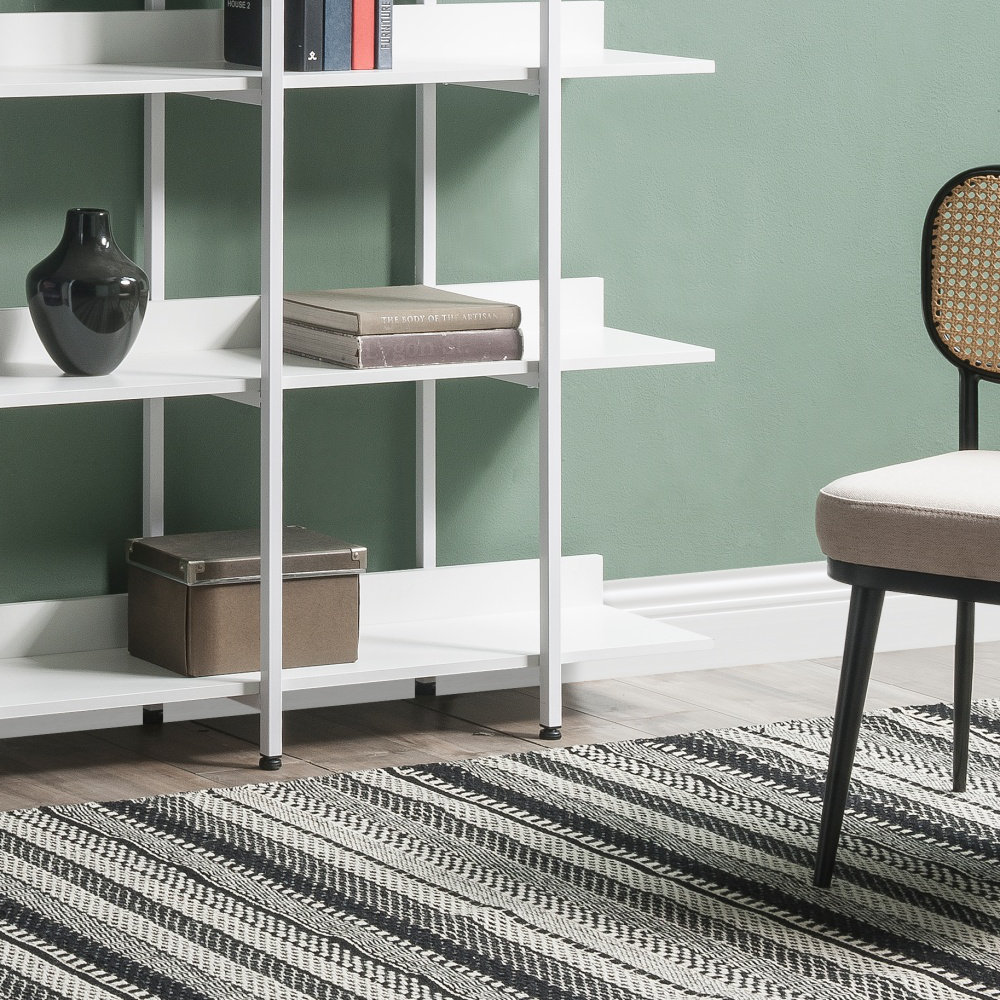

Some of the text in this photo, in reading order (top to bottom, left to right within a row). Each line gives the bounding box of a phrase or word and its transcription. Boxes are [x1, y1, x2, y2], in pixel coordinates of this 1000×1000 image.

[227, 0, 246, 9] HOUSE
[380, 1, 391, 50] FURNITURE
[380, 316, 399, 325] THE
[402, 315, 426, 324] BODY
[427, 314, 440, 323] OF
[462, 312, 498, 321] ARTISAN
